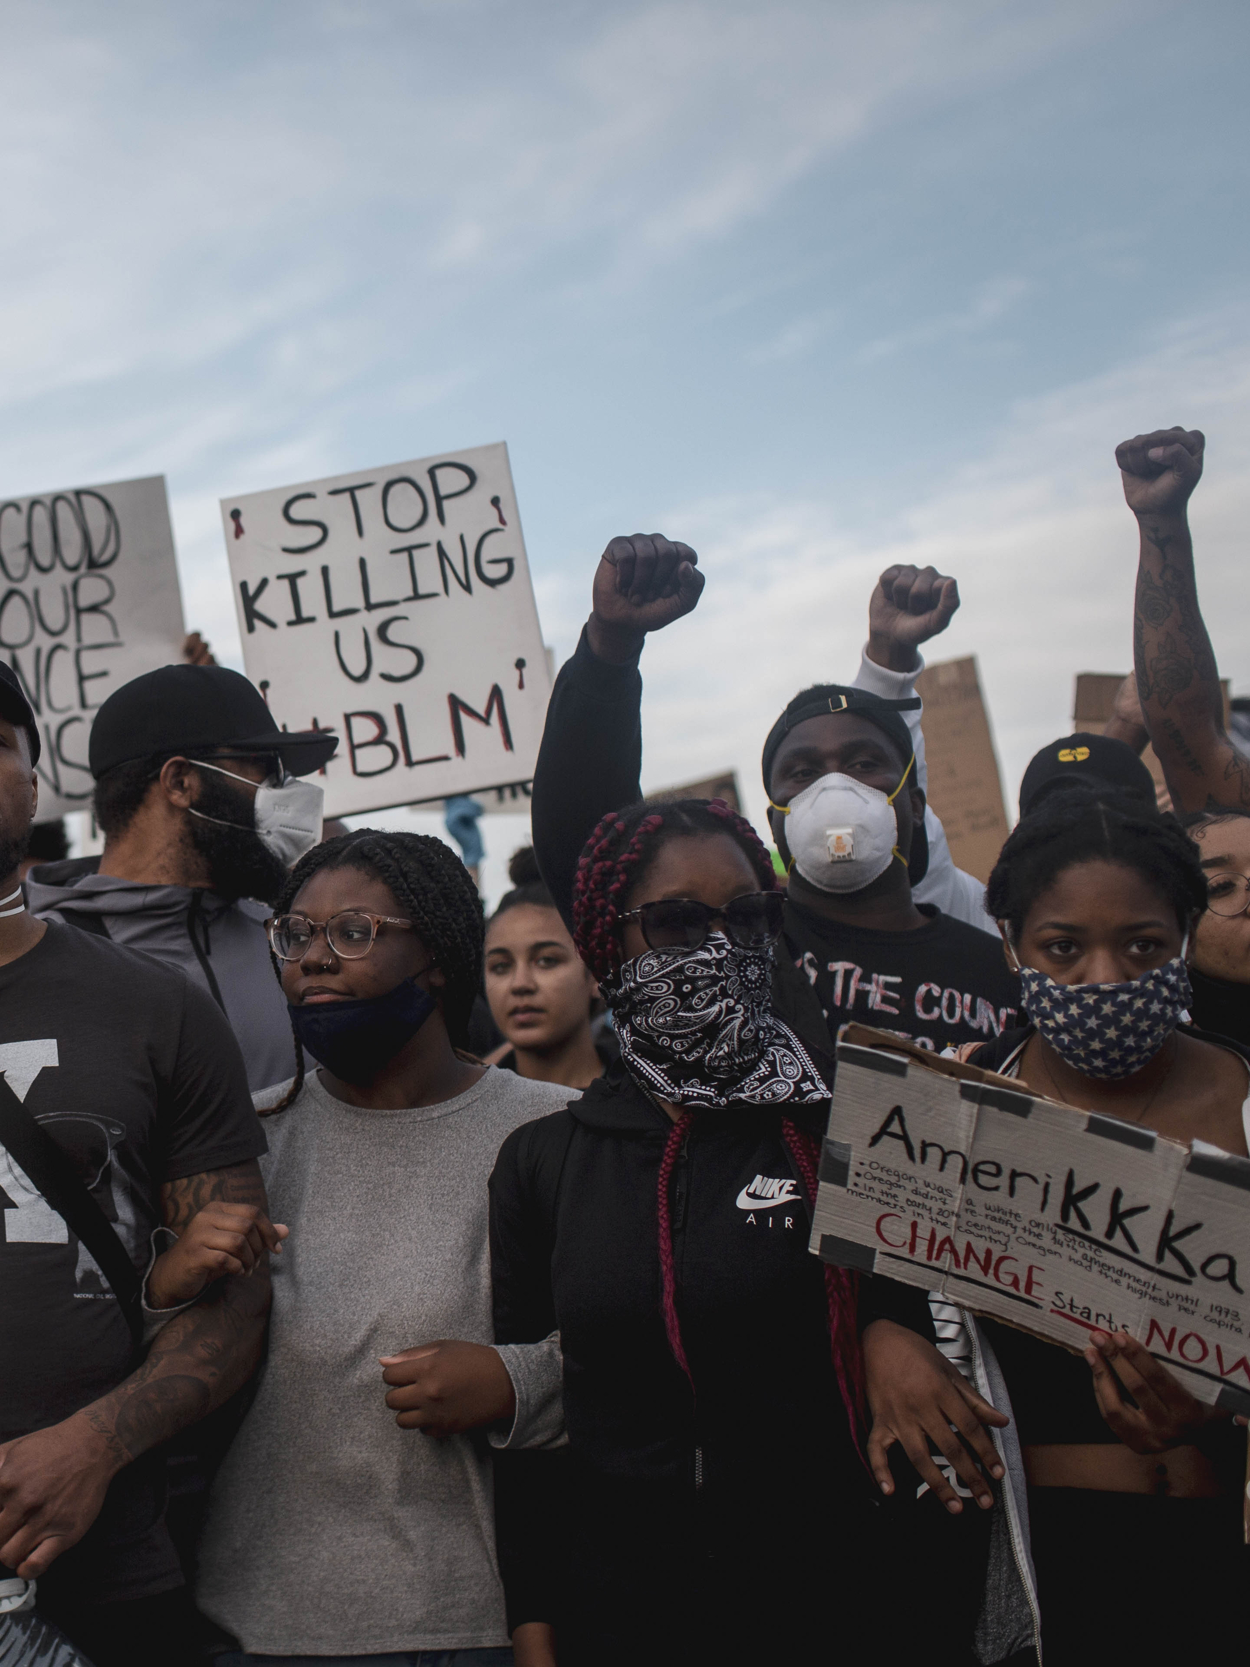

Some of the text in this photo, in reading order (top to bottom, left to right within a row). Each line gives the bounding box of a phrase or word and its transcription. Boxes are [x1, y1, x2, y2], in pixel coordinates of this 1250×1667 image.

[281, 461, 478, 554] STOP
[239, 527, 515, 634] KILLING
[334, 615, 425, 684] US
[827, 960, 903, 1015] THE
[746, 1213, 794, 1229] AIR
[747, 1174, 798, 1199] NIKE
[846, 1188, 906, 1213] members
[912, 1210, 925, 1220] in
[928, 1216, 952, 1230] the
[868, 1105, 1245, 1295] AmeriKKKa
[869, 1161, 918, 1184] Oregon
[924, 1180, 953, 1198] was
[965, 1198, 976, 1208] a
[984, 1202, 1023, 1222] white
[1028, 1219, 1058, 1237] only
[863, 1171, 906, 1191] Oregon
[965, 1207, 1018, 1234] re-ratify
[1021, 1225, 1044, 1240] the
[1081, 1252, 1163, 1293] amendment
[1166, 1290, 1200, 1308] until
[863, 1183, 875, 1194] In
[880, 1189, 899, 1203] the
[905, 1198, 932, 1215] early
[966, 1220, 1011, 1243] century
[1015, 1236, 1063, 1259] Oregon
[1068, 1255, 1093, 1272] had
[1098, 1268, 1123, 1287] the
[1127, 1284, 1172, 1308] highest
[875, 1212, 1046, 1301] CHANGE
